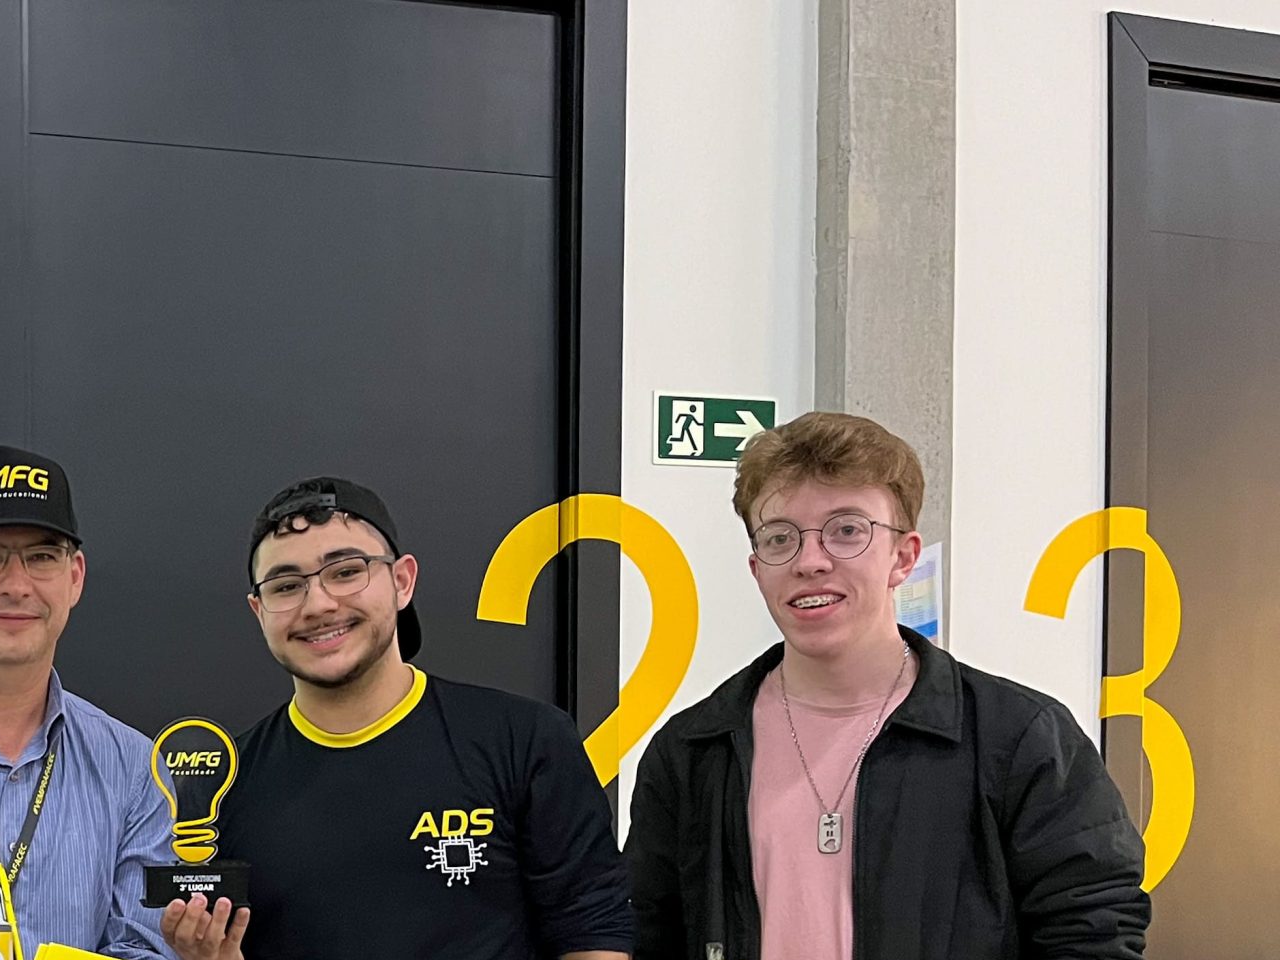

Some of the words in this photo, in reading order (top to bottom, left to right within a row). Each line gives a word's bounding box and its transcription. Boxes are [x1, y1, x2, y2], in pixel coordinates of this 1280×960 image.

[477, 493, 699, 787] 2
[1023, 506, 1195, 892] 3
[166, 751, 222, 768] UMFG
[170, 768, 216, 776] Faculdade
[409, 808, 494, 840] ADS
[172, 874, 221, 883] HACKATHON
[187, 883, 215, 892] LUGAR
